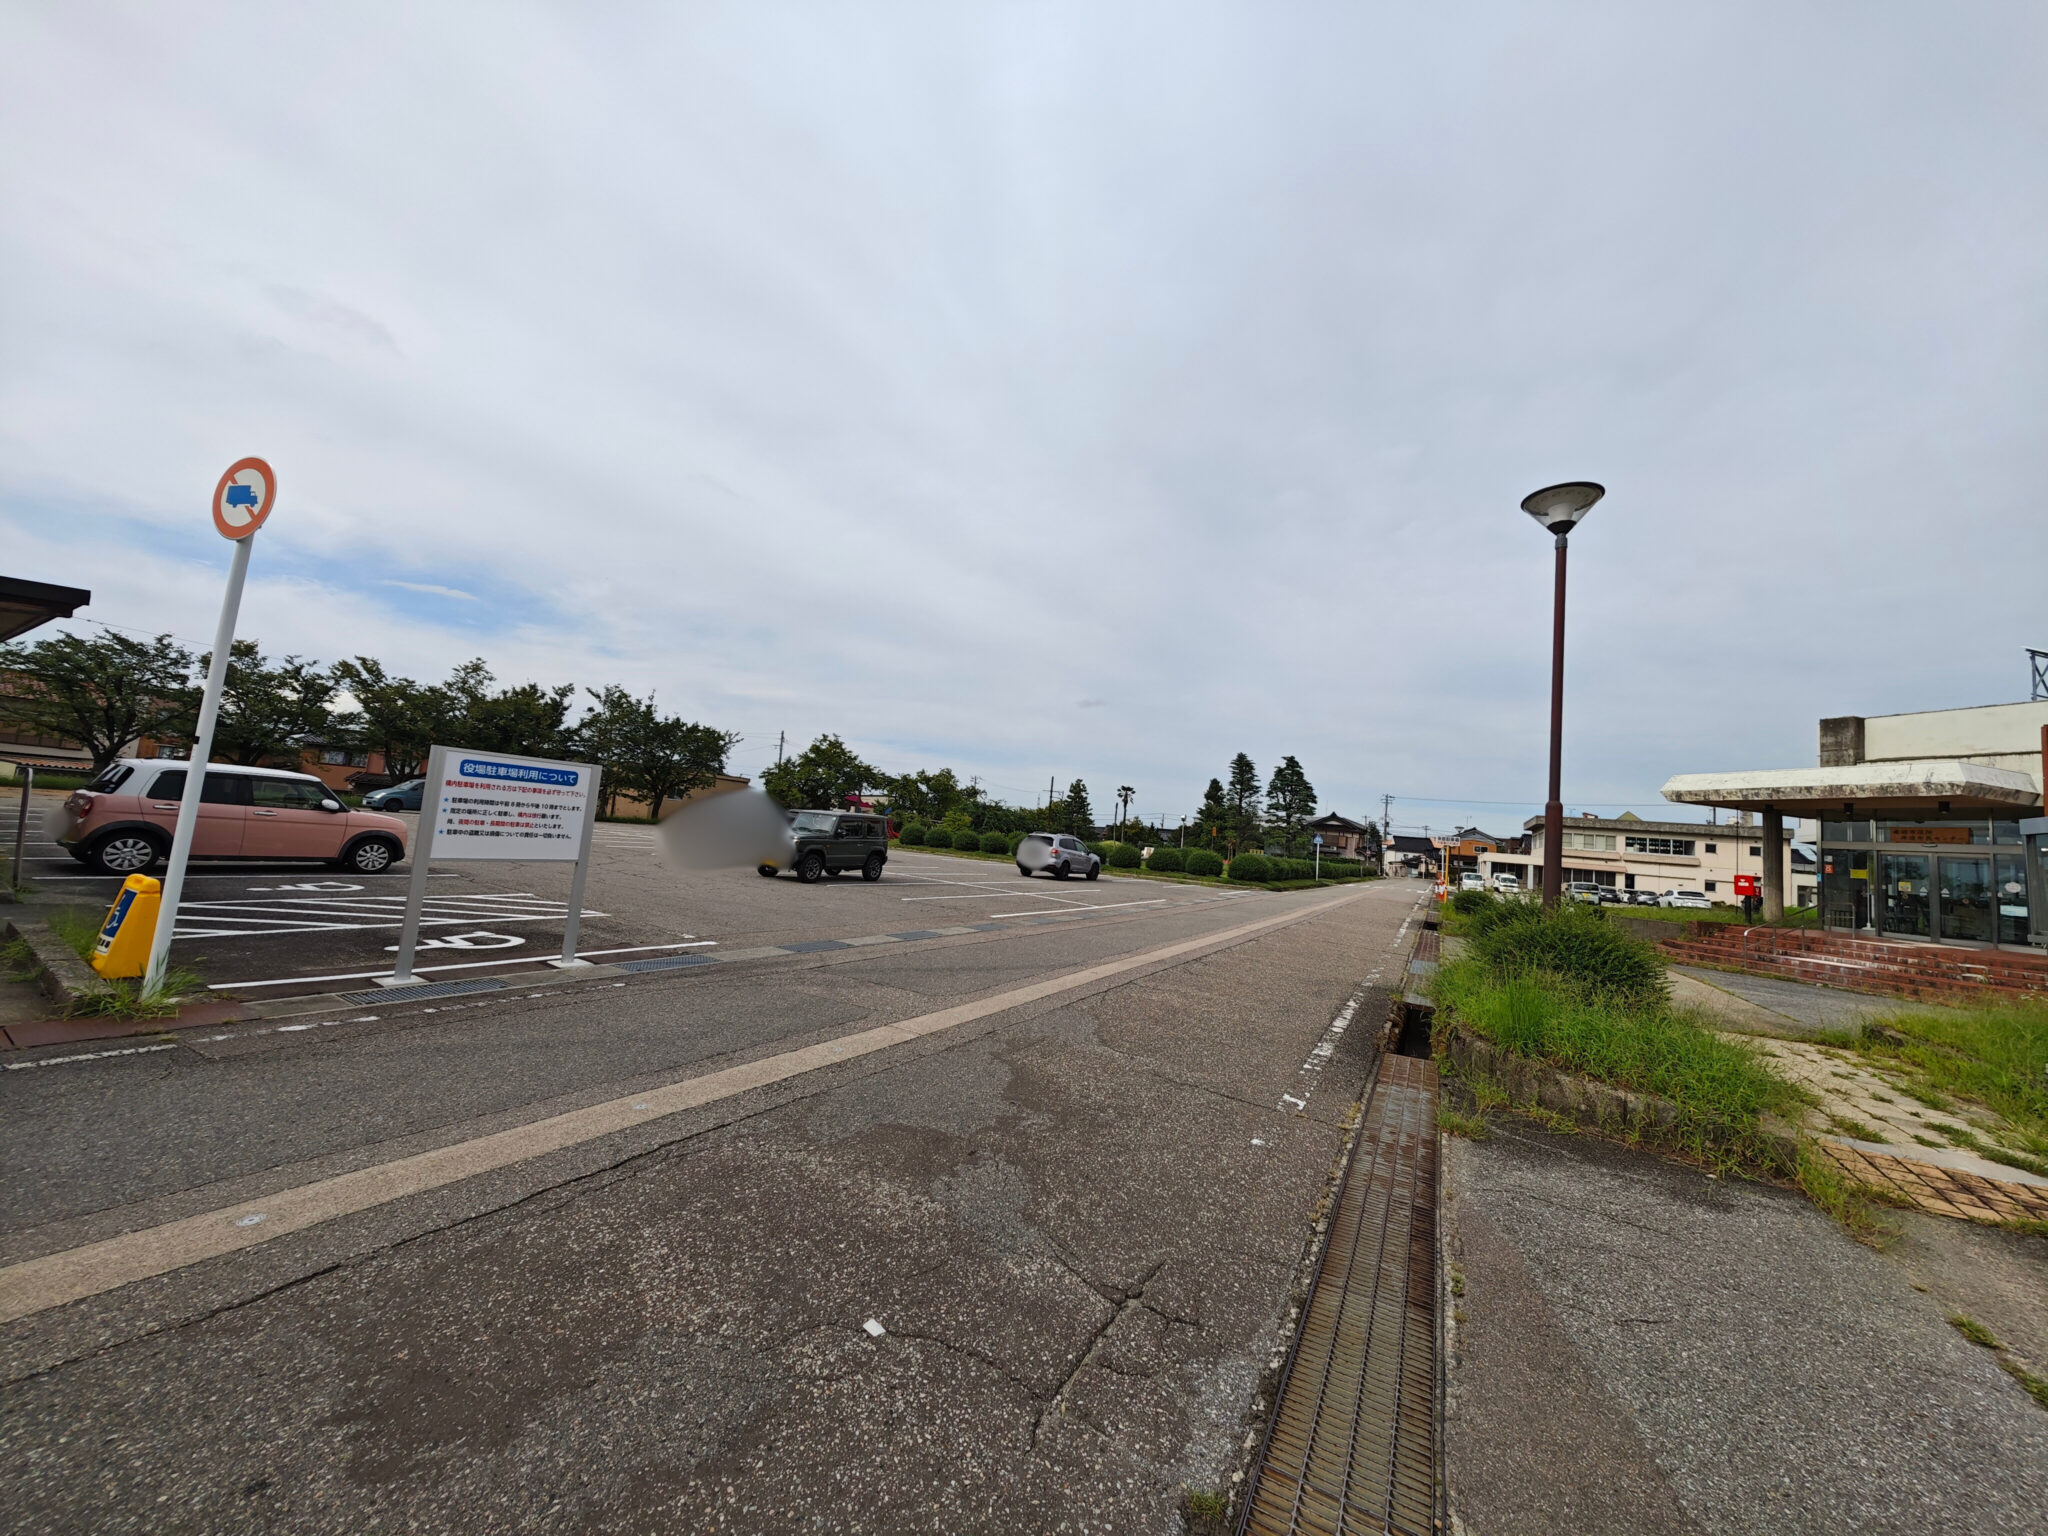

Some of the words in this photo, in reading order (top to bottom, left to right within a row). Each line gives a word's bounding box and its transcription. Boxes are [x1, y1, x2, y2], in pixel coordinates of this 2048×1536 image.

[463, 763, 577, 783] 役場駐車場利用について
